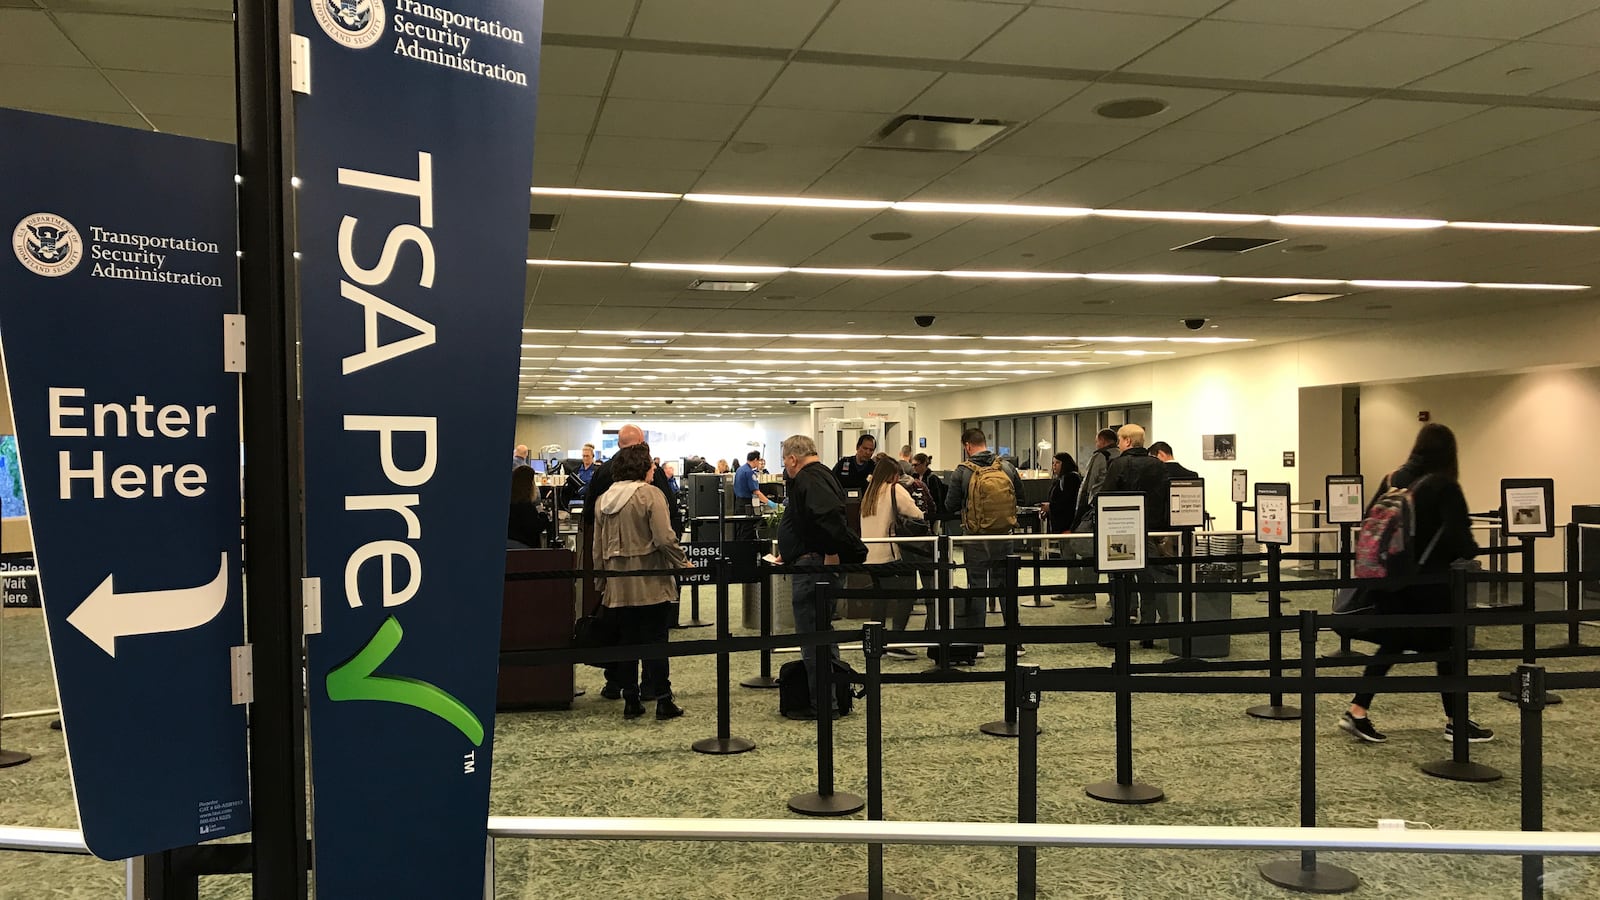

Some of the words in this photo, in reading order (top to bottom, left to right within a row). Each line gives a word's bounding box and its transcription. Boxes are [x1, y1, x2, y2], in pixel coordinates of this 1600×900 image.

[315, 3, 351, 43] HOMELAND
[354, 20, 381, 44] SECURITY
[394, 14, 470, 54] Security
[396, 0, 524, 44] Transportation
[394, 36, 528, 86] Administration
[17, 245, 50, 273] HOMELAND
[53, 251, 79, 274] SECURITY
[90, 226, 219, 254] Transportation
[92, 245, 166, 269] Security
[91, 262, 222, 287] Administration
[337, 151, 436, 375] TSA
[49, 387, 217, 438] Enter
[59, 450, 208, 499] Here
[343, 415, 438, 609] Pre
